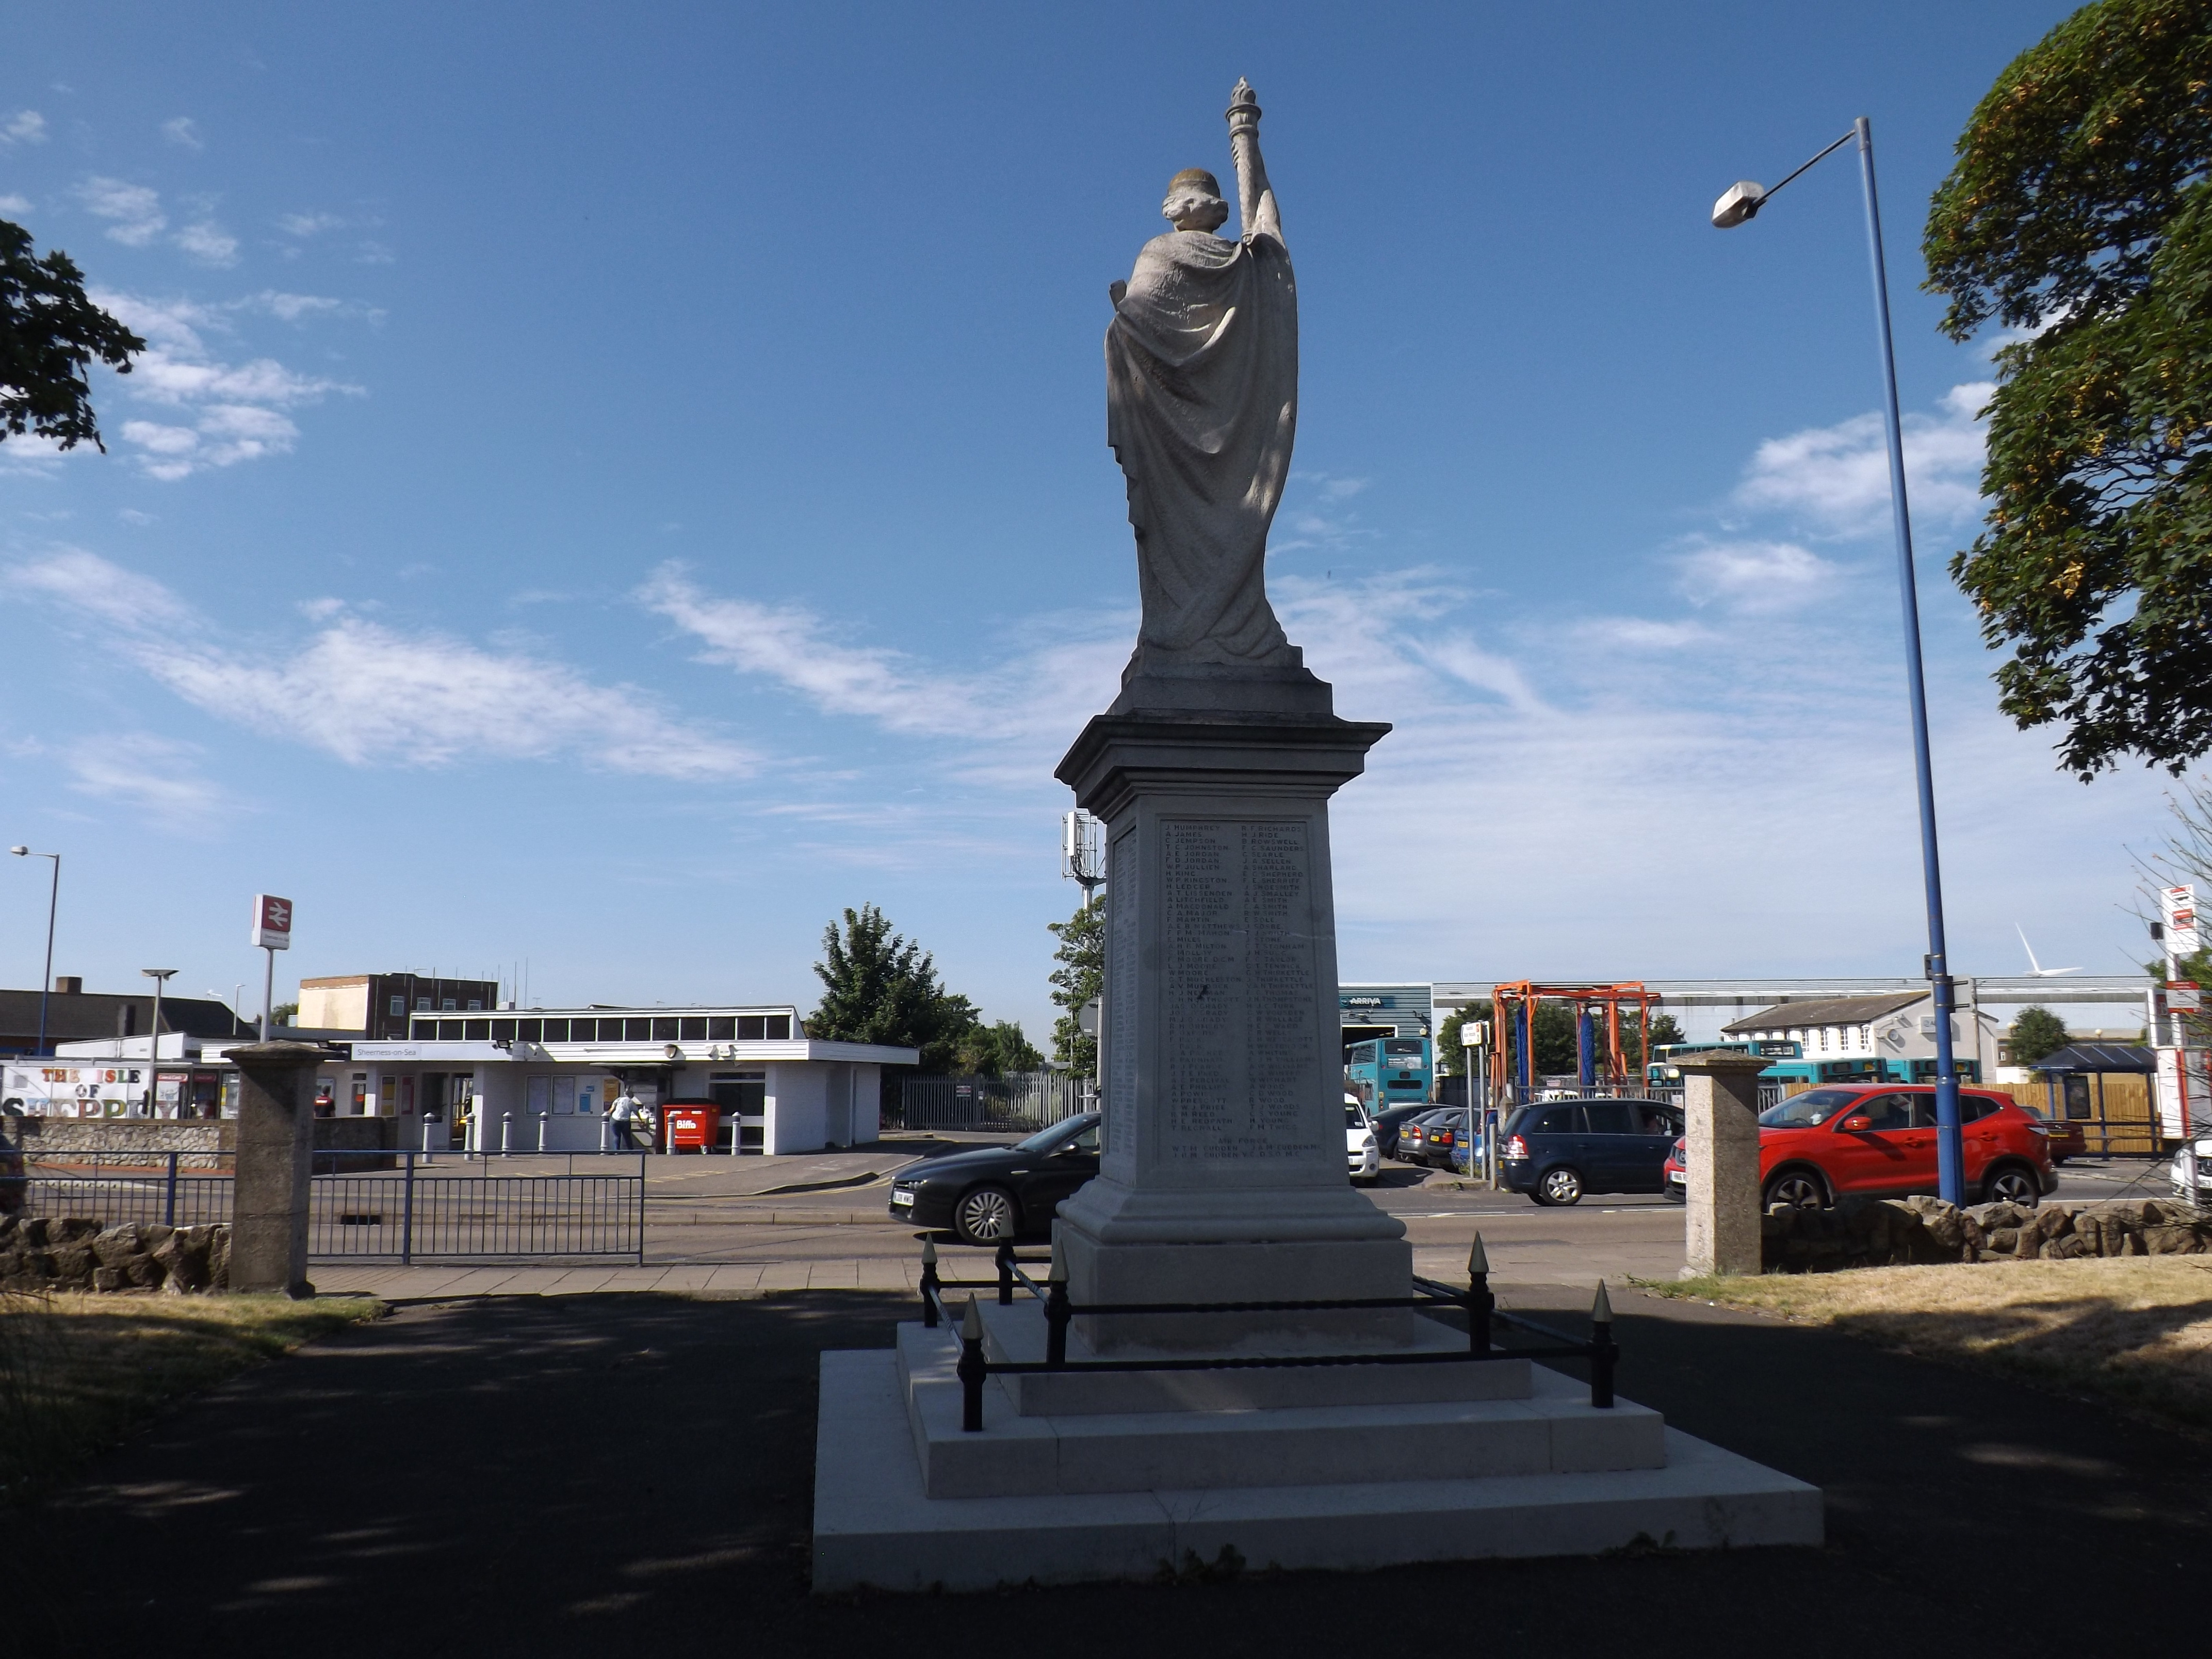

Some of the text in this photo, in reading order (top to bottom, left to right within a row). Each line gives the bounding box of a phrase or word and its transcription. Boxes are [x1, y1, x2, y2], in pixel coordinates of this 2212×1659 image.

[42, 1068, 80, 1083] THE
[96, 1069, 142, 1083] ISLE
[75, 1084, 102, 1098] OF
[676, 1120, 696, 1129] Biffa
